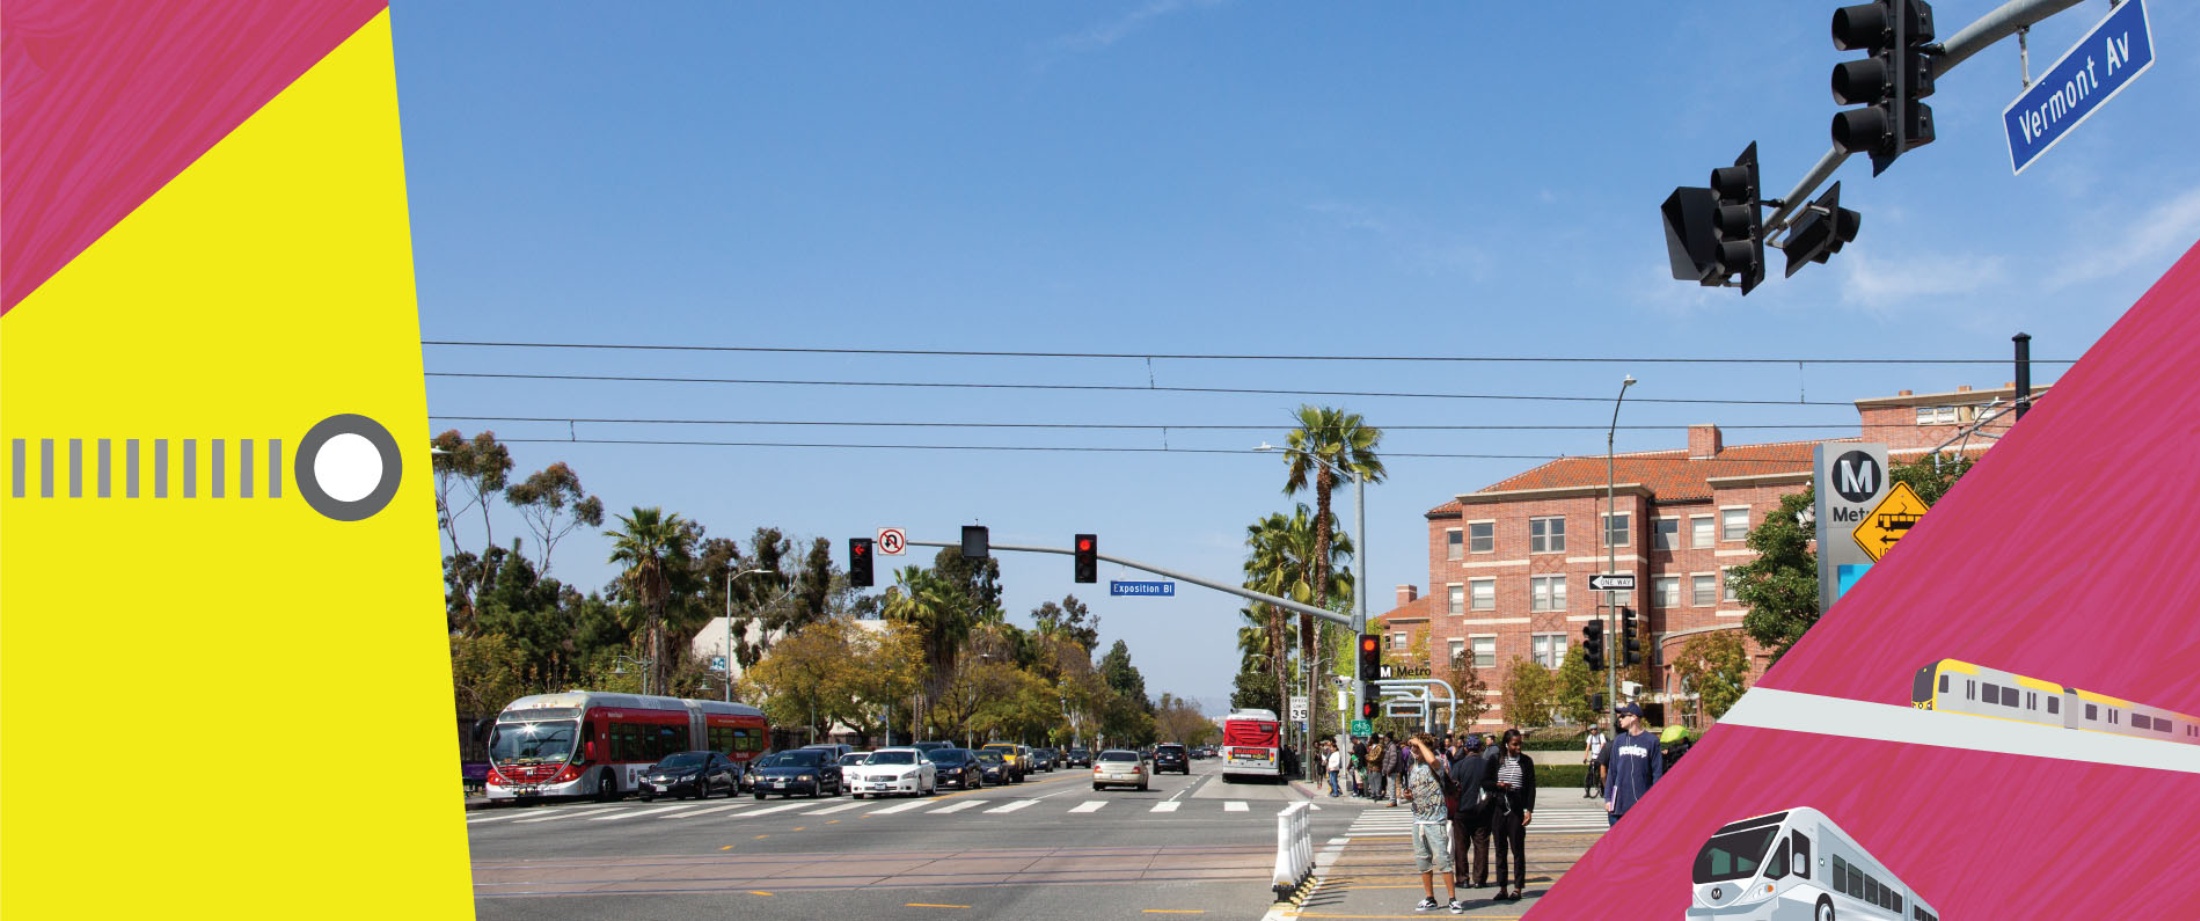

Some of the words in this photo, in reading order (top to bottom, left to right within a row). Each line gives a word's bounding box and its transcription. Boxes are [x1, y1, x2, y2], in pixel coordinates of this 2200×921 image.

[2019, 55, 2098, 145] Vermont
[2106, 31, 2129, 77] Av
[1841, 460, 1873, 493] M
[1833, 506, 1870, 522] Met
[1113, 584, 1160, 594] Exposition
[1163, 584, 1172, 593] Bl
[1396, 665, 1432, 677] Metro
